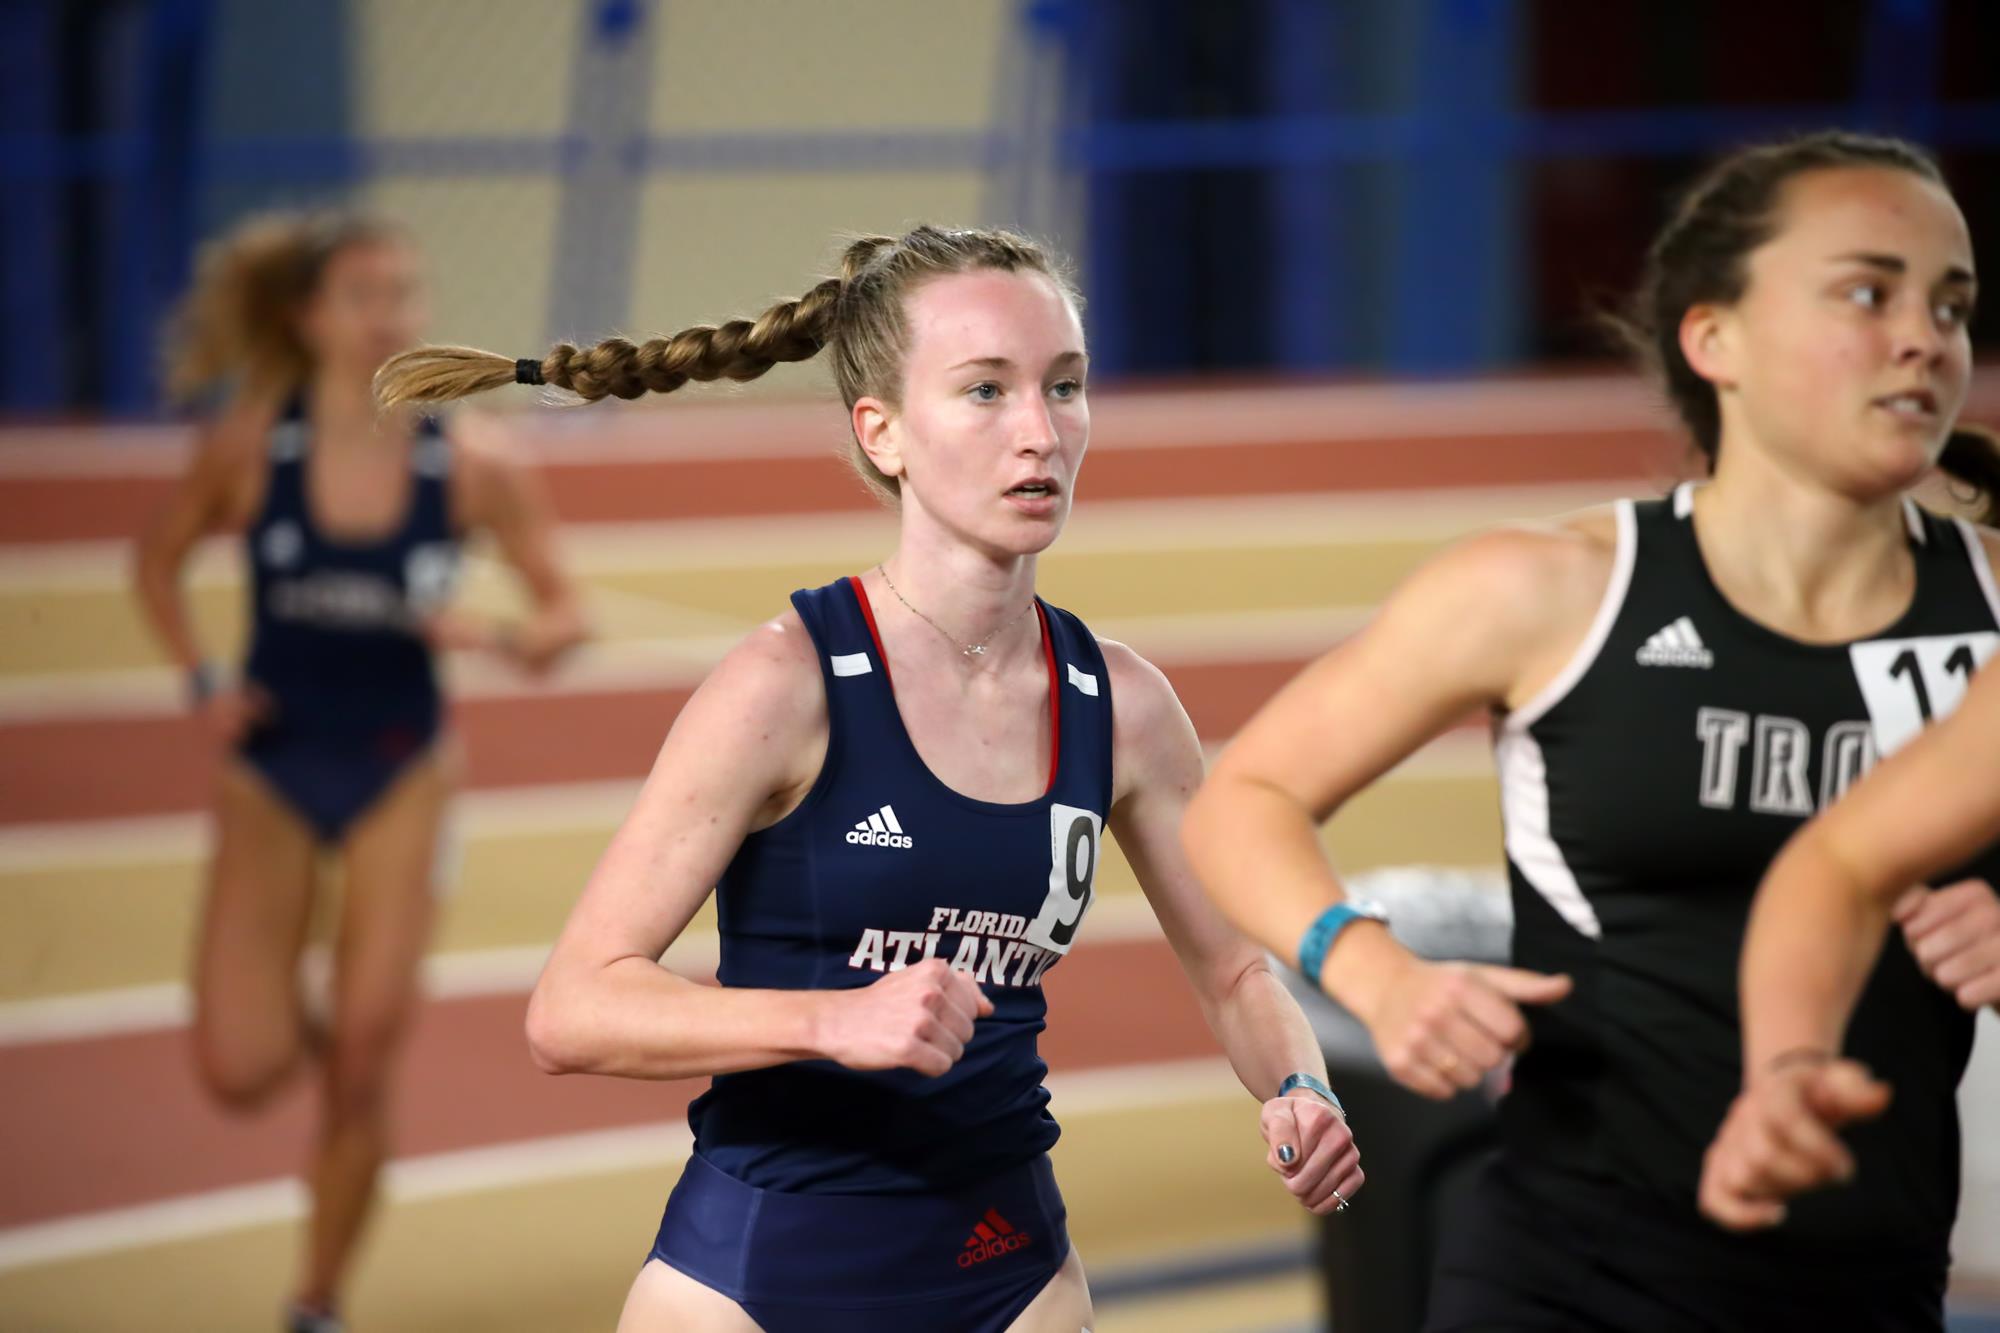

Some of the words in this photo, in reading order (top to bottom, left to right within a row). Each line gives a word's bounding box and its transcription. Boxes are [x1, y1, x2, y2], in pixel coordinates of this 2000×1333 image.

[845, 829, 913, 849] adidas
[1049, 815, 1095, 946] 9
[927, 907, 1028, 940] FLORID
[957, 1232, 1031, 1268] adidas
